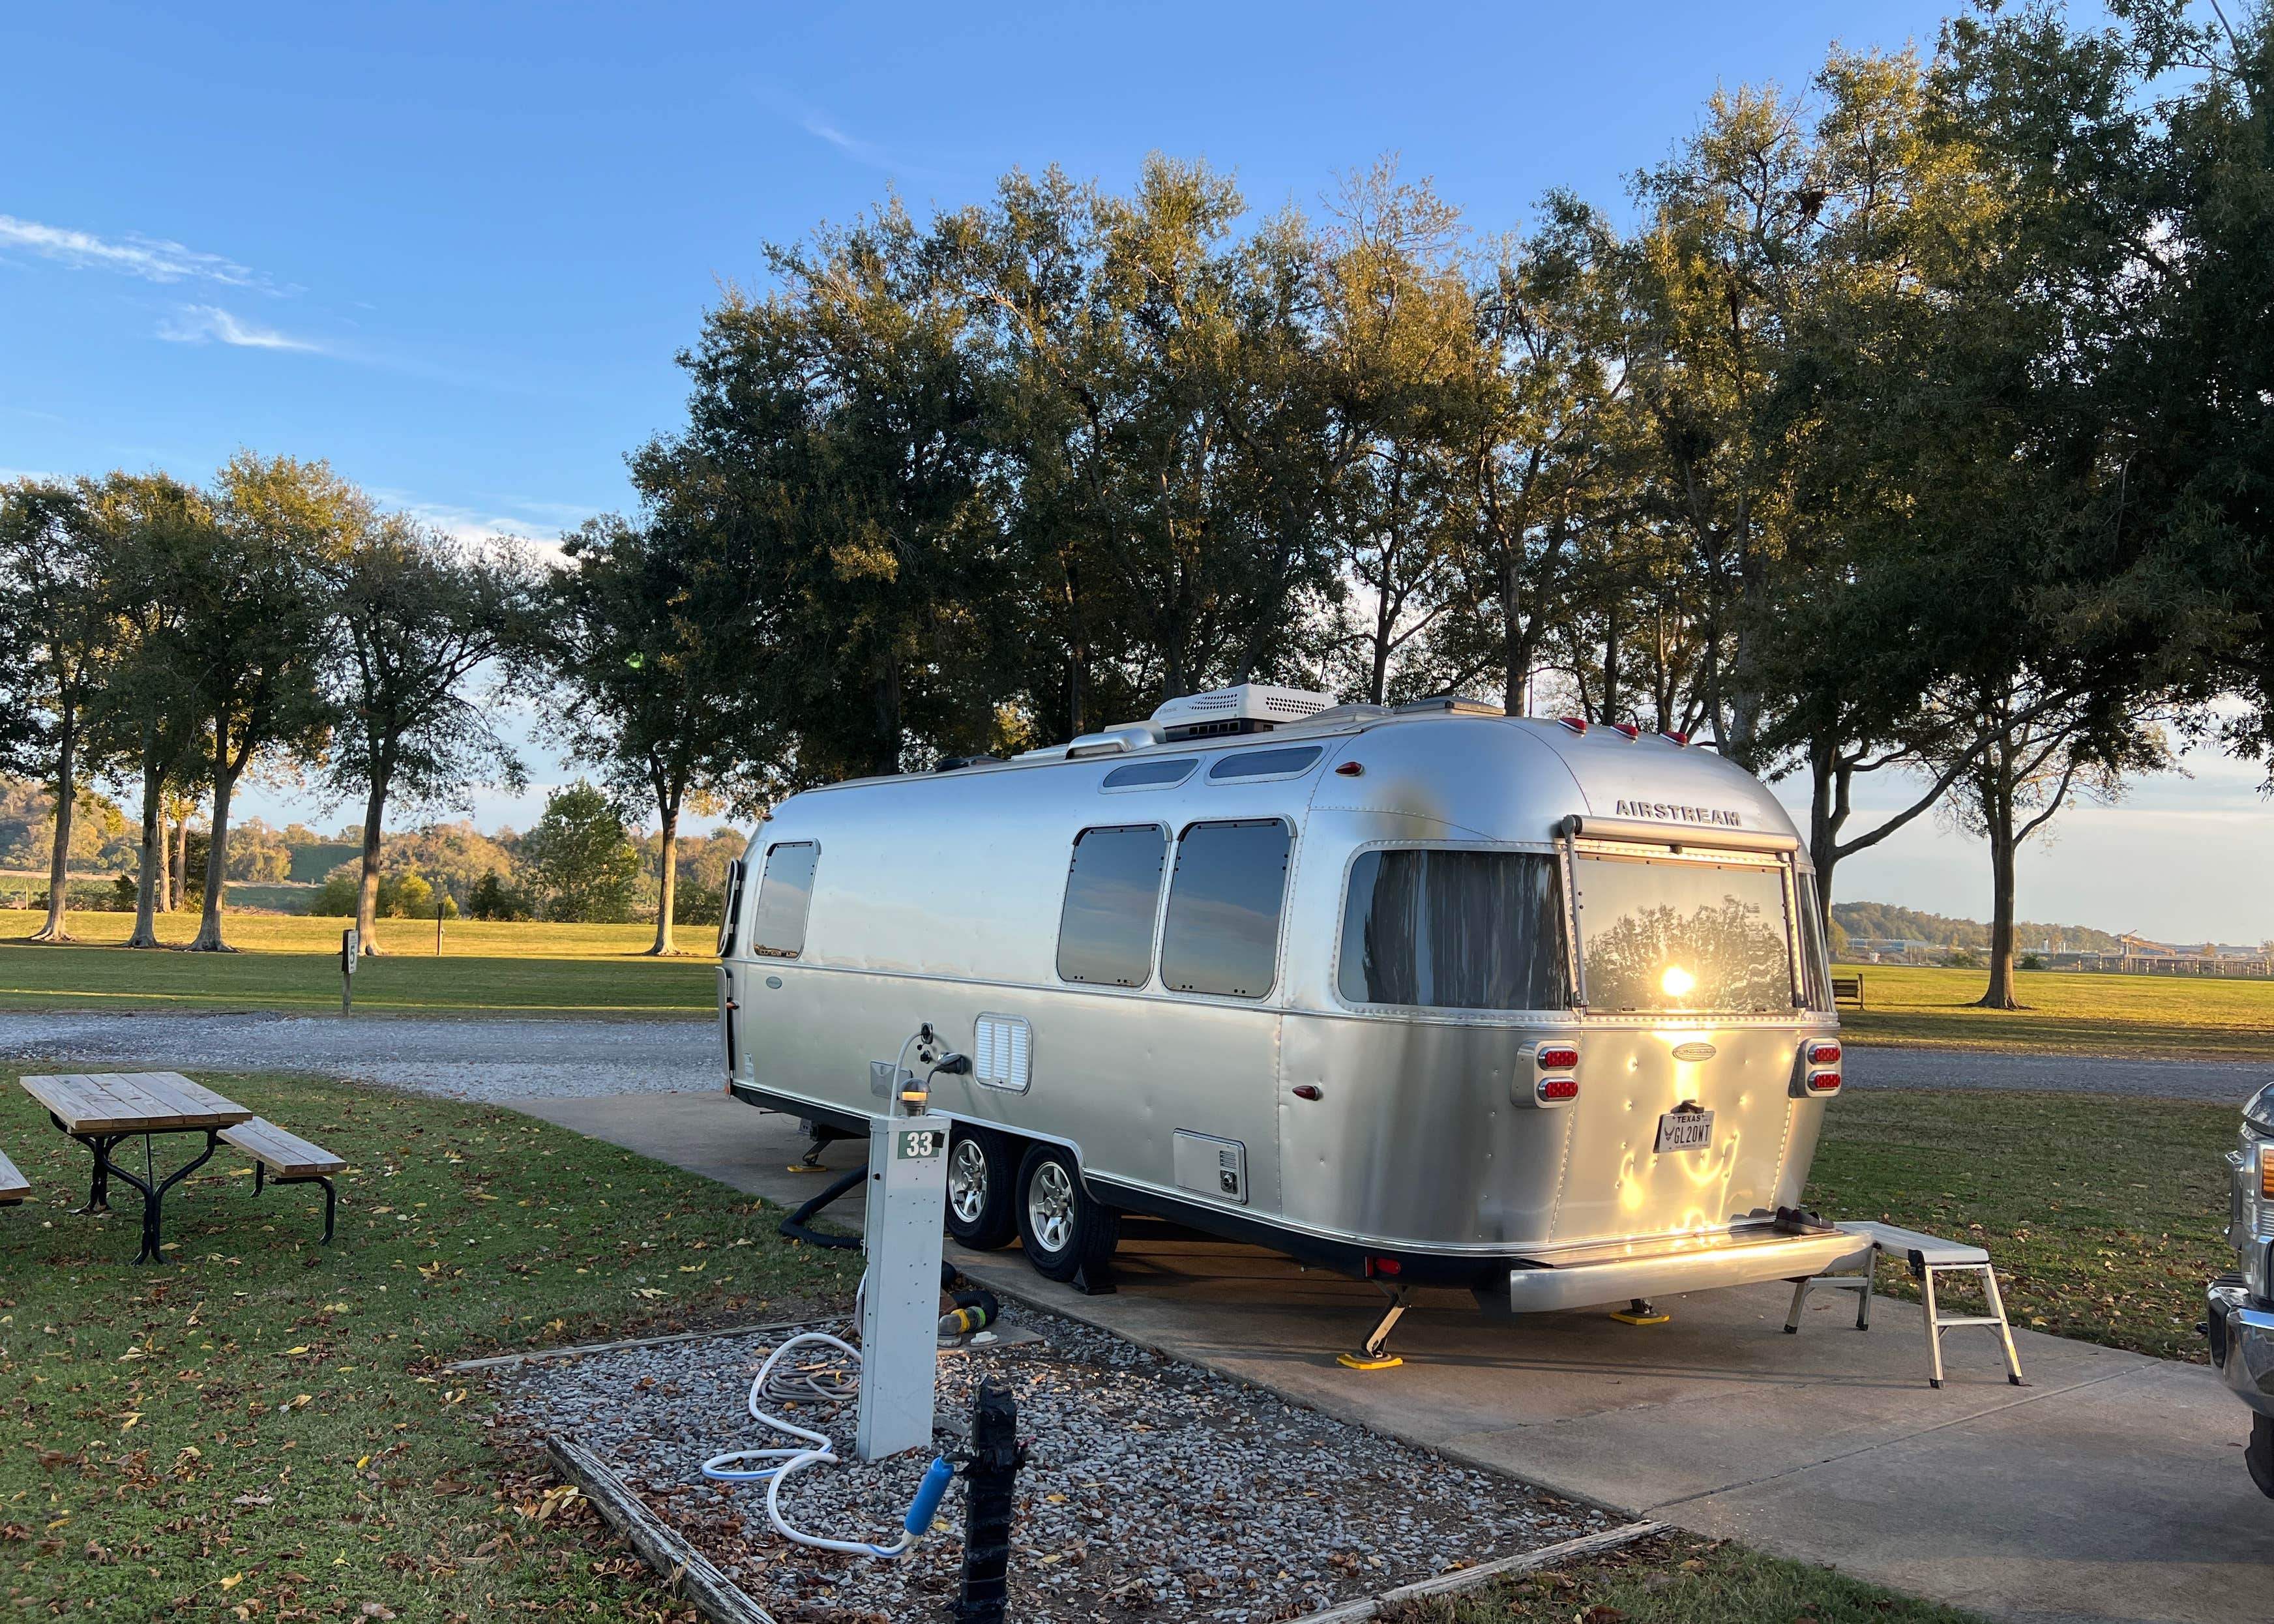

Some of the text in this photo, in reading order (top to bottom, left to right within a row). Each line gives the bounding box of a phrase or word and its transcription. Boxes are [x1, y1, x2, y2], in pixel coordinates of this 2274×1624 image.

[1617, 800, 1741, 826] AIRSTREAM
[350, 945, 355, 964] 5
[907, 1132, 933, 1157] 33
